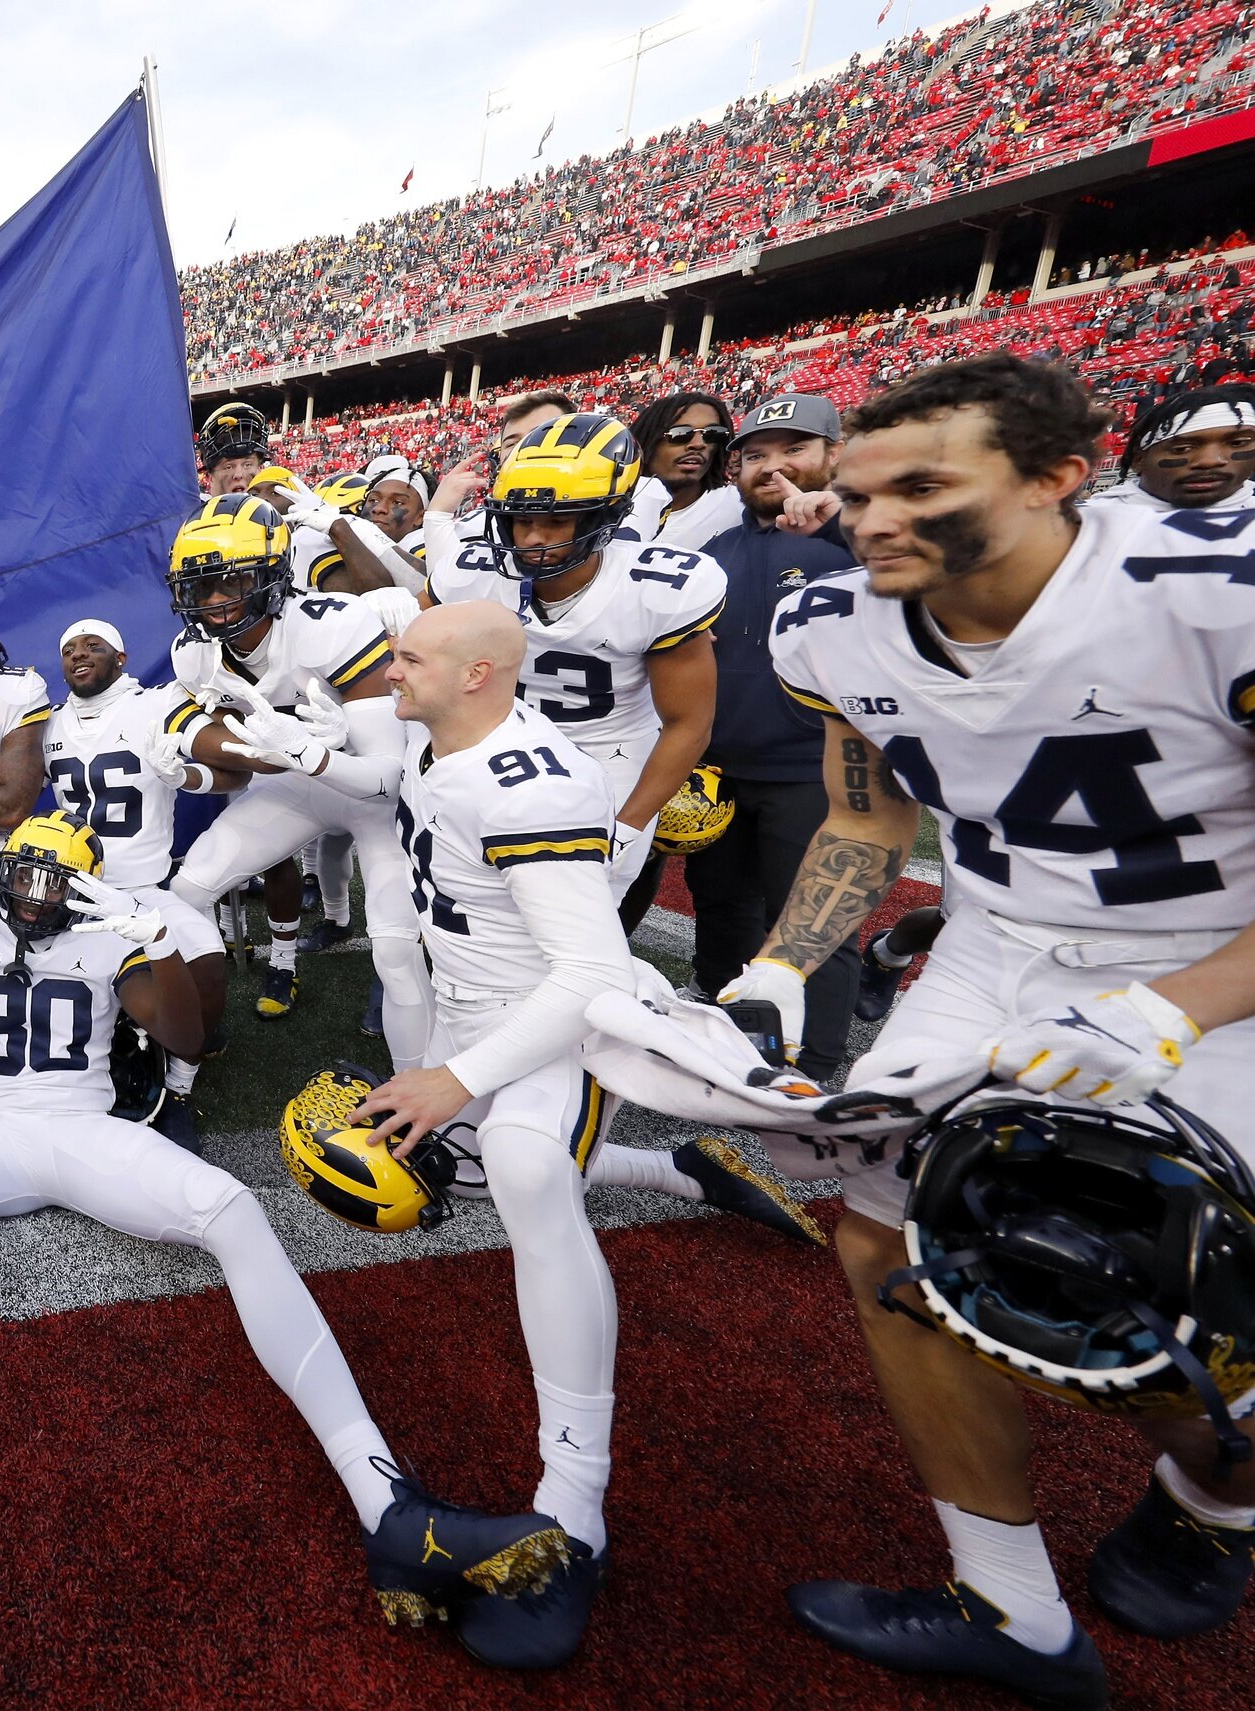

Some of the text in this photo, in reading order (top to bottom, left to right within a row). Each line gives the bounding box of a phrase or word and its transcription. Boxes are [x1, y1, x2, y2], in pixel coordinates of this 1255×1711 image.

[761, 404, 792, 419] M
[525, 489, 537, 497] M
[630, 547, 702, 590] 13
[299, 597, 348, 620] 4
[488, 747, 571, 788] 91
[50, 750, 143, 838] 36
[884, 729, 1225, 906] 14
[33, 848, 45, 858] M
